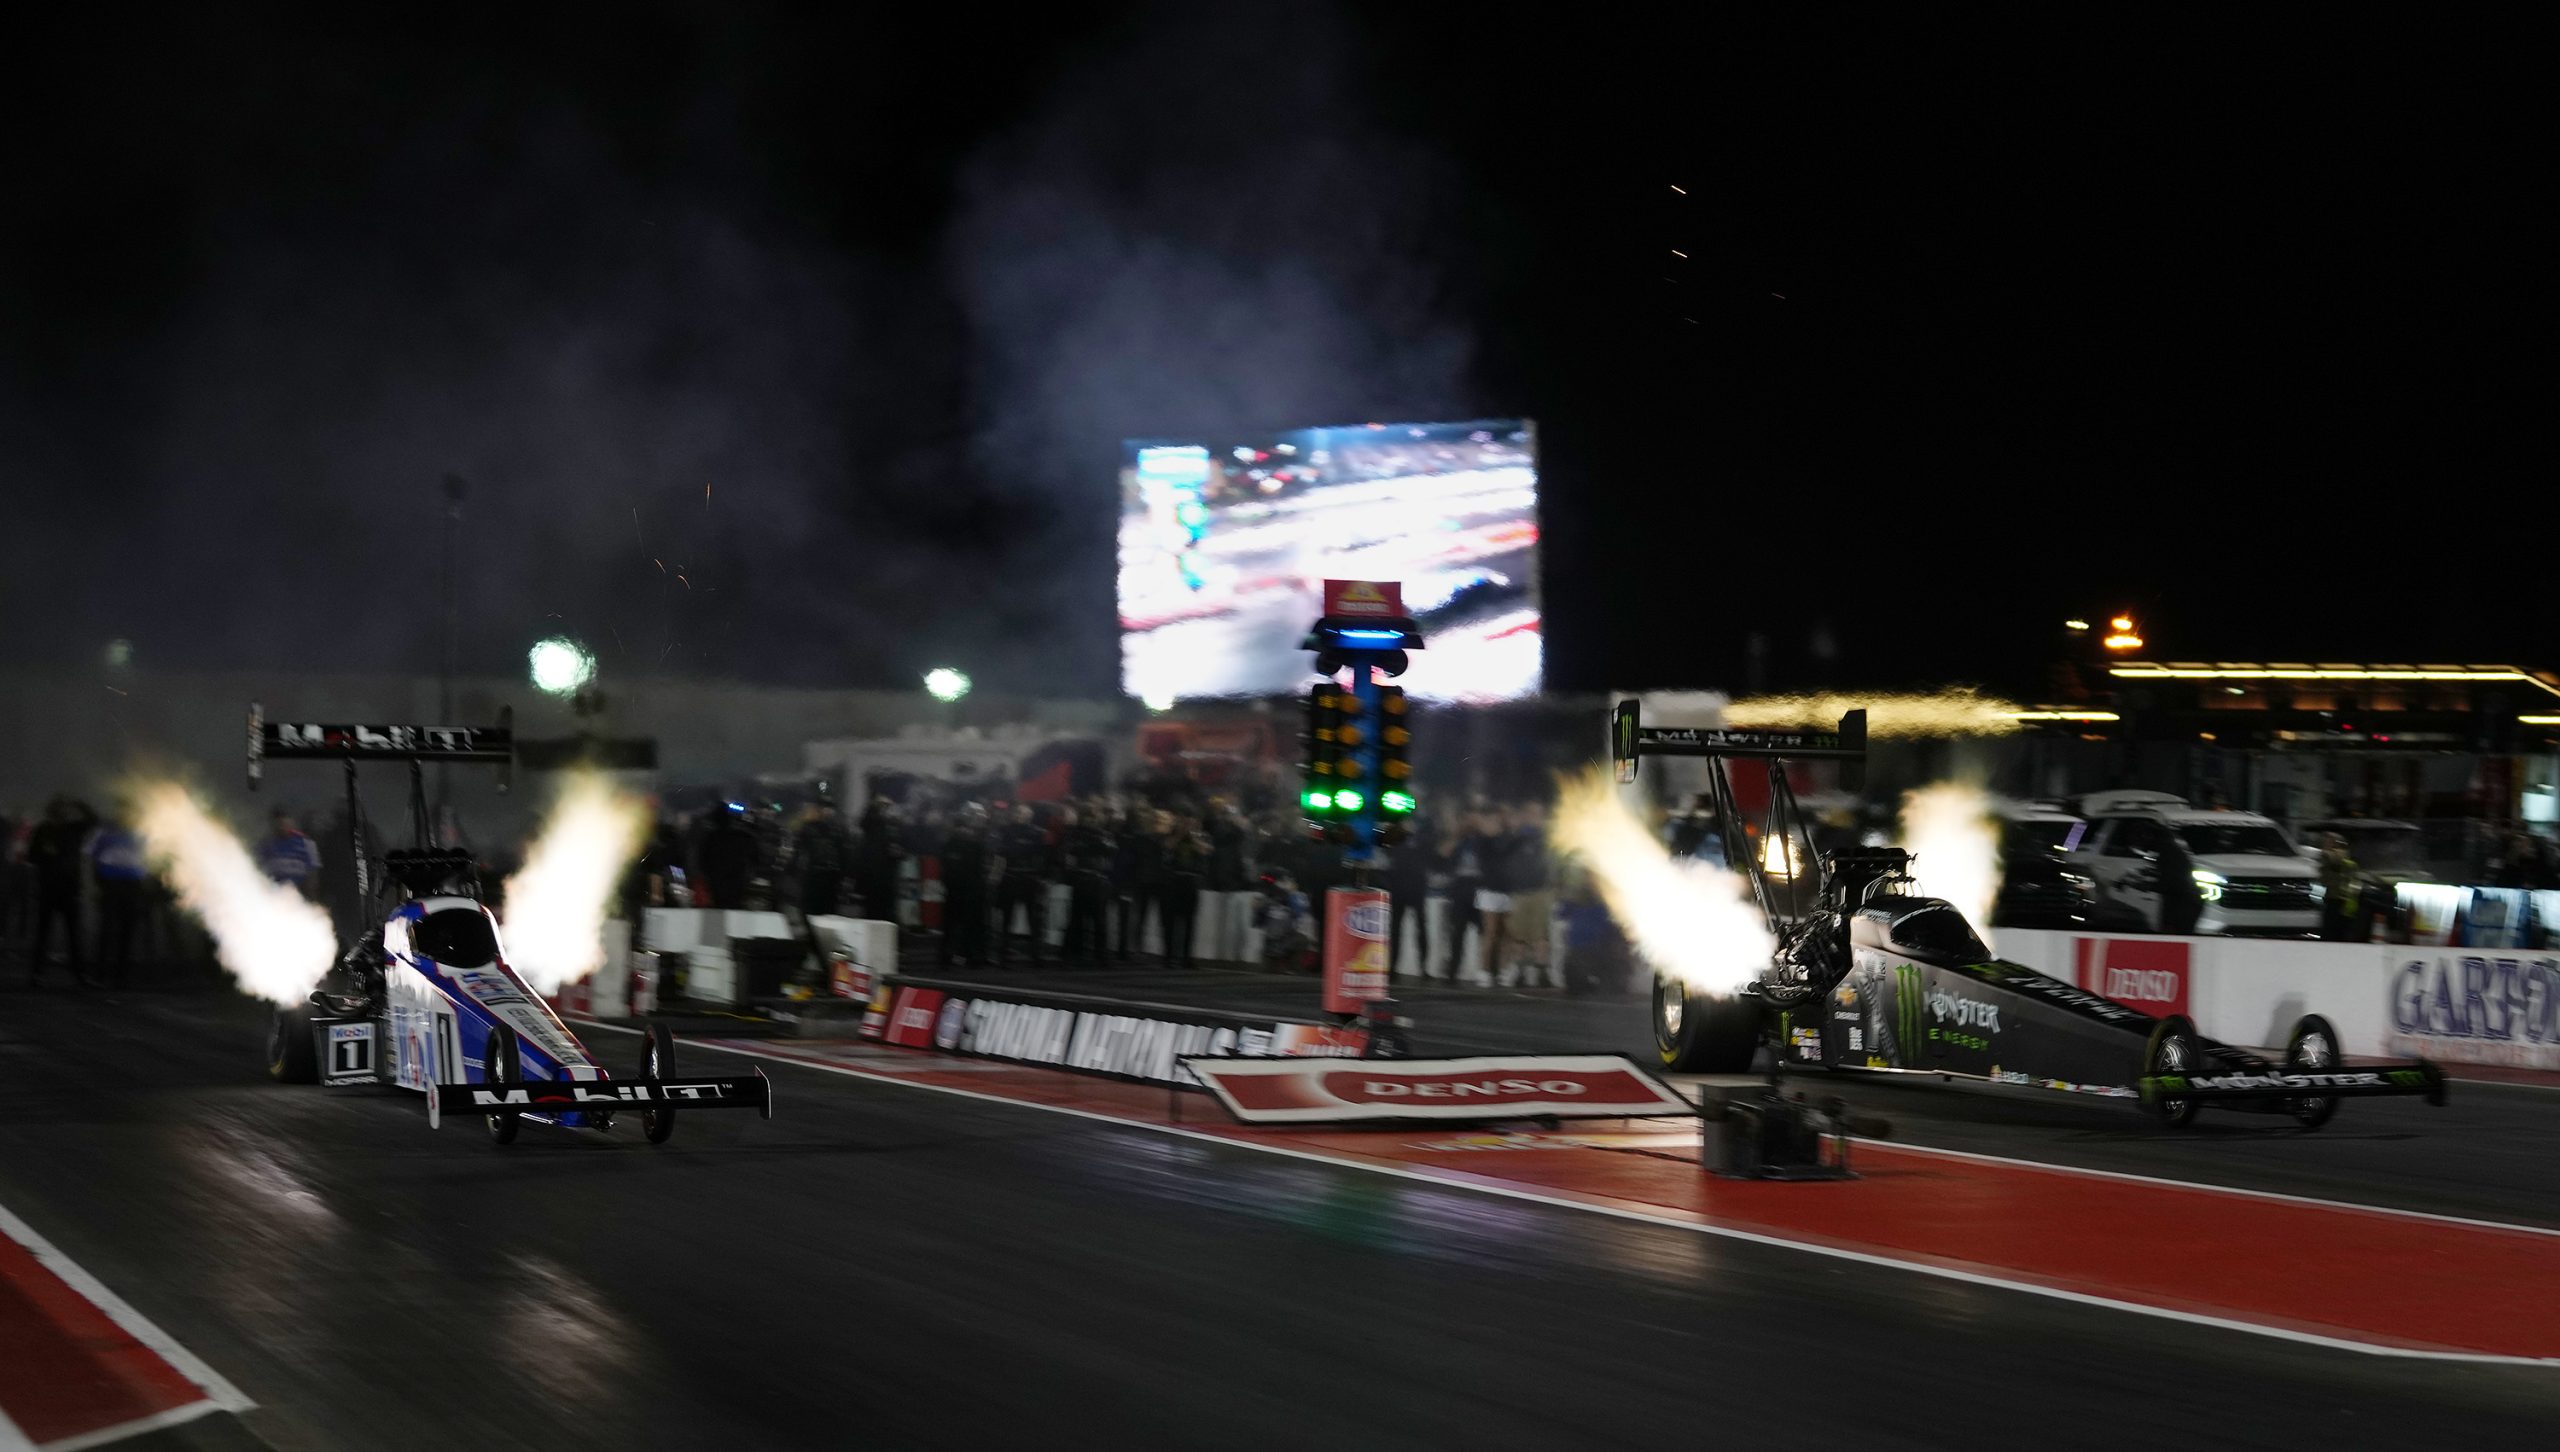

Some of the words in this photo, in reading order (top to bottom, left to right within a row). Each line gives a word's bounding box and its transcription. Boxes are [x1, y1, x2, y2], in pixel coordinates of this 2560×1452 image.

[2105, 967, 2179, 1004] DENSO
[1922, 988, 2001, 1034] MONSTER
[342, 1041, 359, 1069] 1
[1363, 1079, 1588, 1098] DENSO
[2189, 1071, 2391, 1090] MONSTER
